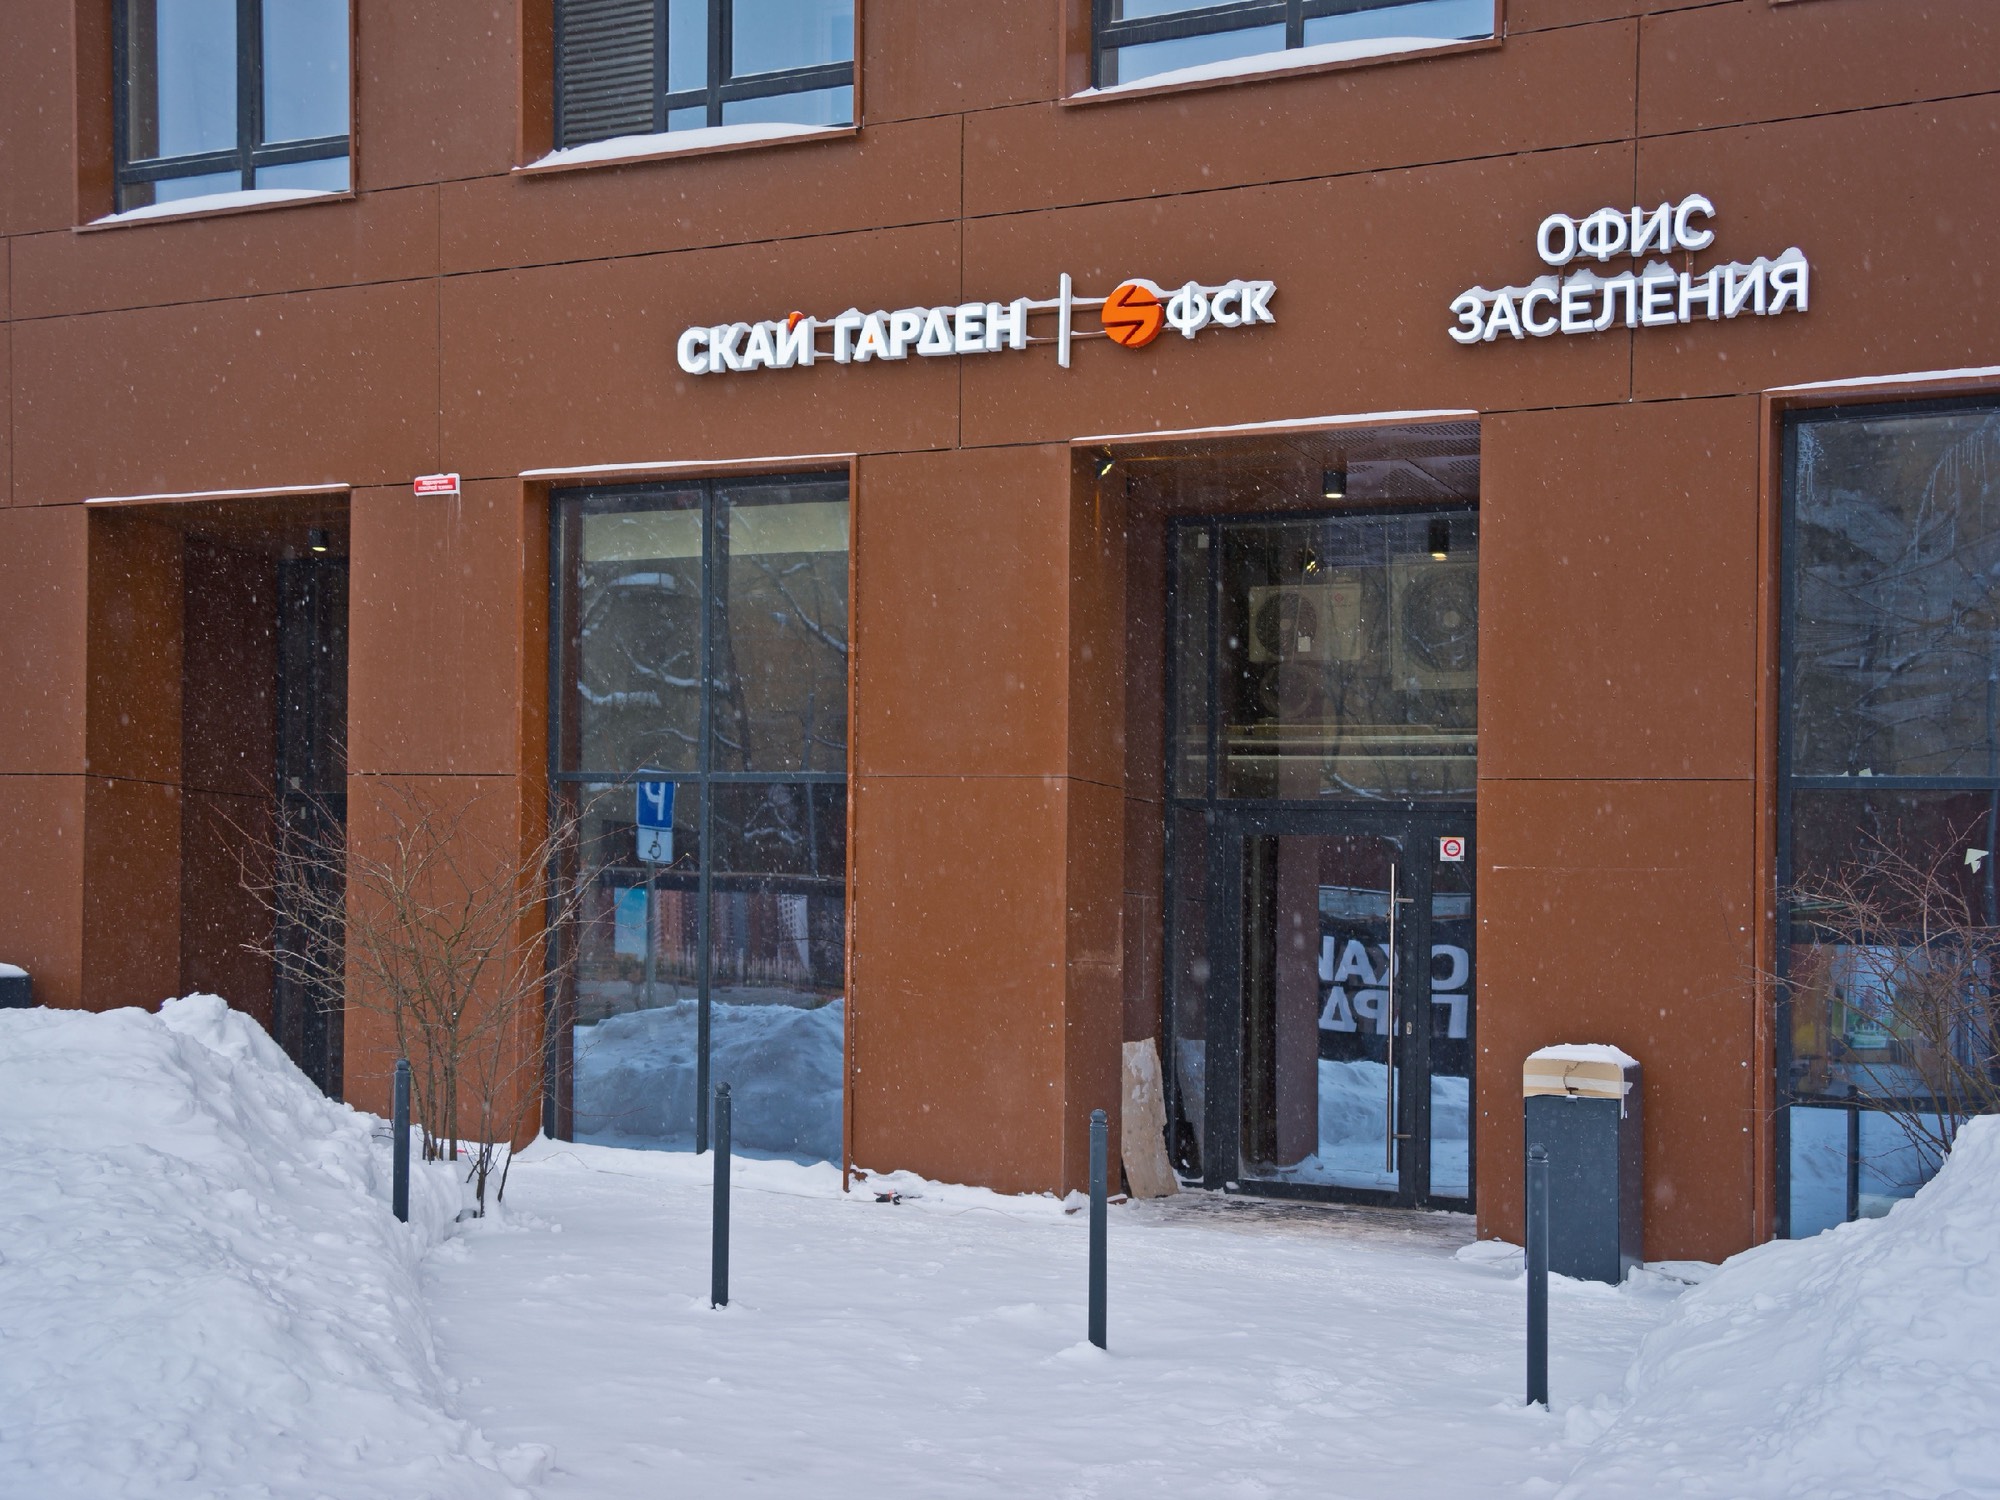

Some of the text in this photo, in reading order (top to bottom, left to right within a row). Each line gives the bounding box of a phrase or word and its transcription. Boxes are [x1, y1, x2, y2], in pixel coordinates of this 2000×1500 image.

[1537, 196, 1716, 266] ОФИС
[1448, 256, 1810, 344] ЗАСЕЛЕНИЯ
[677, 311, 816, 374] СКАЙ
[833, 302, 1028, 364] ГАРДЕН
